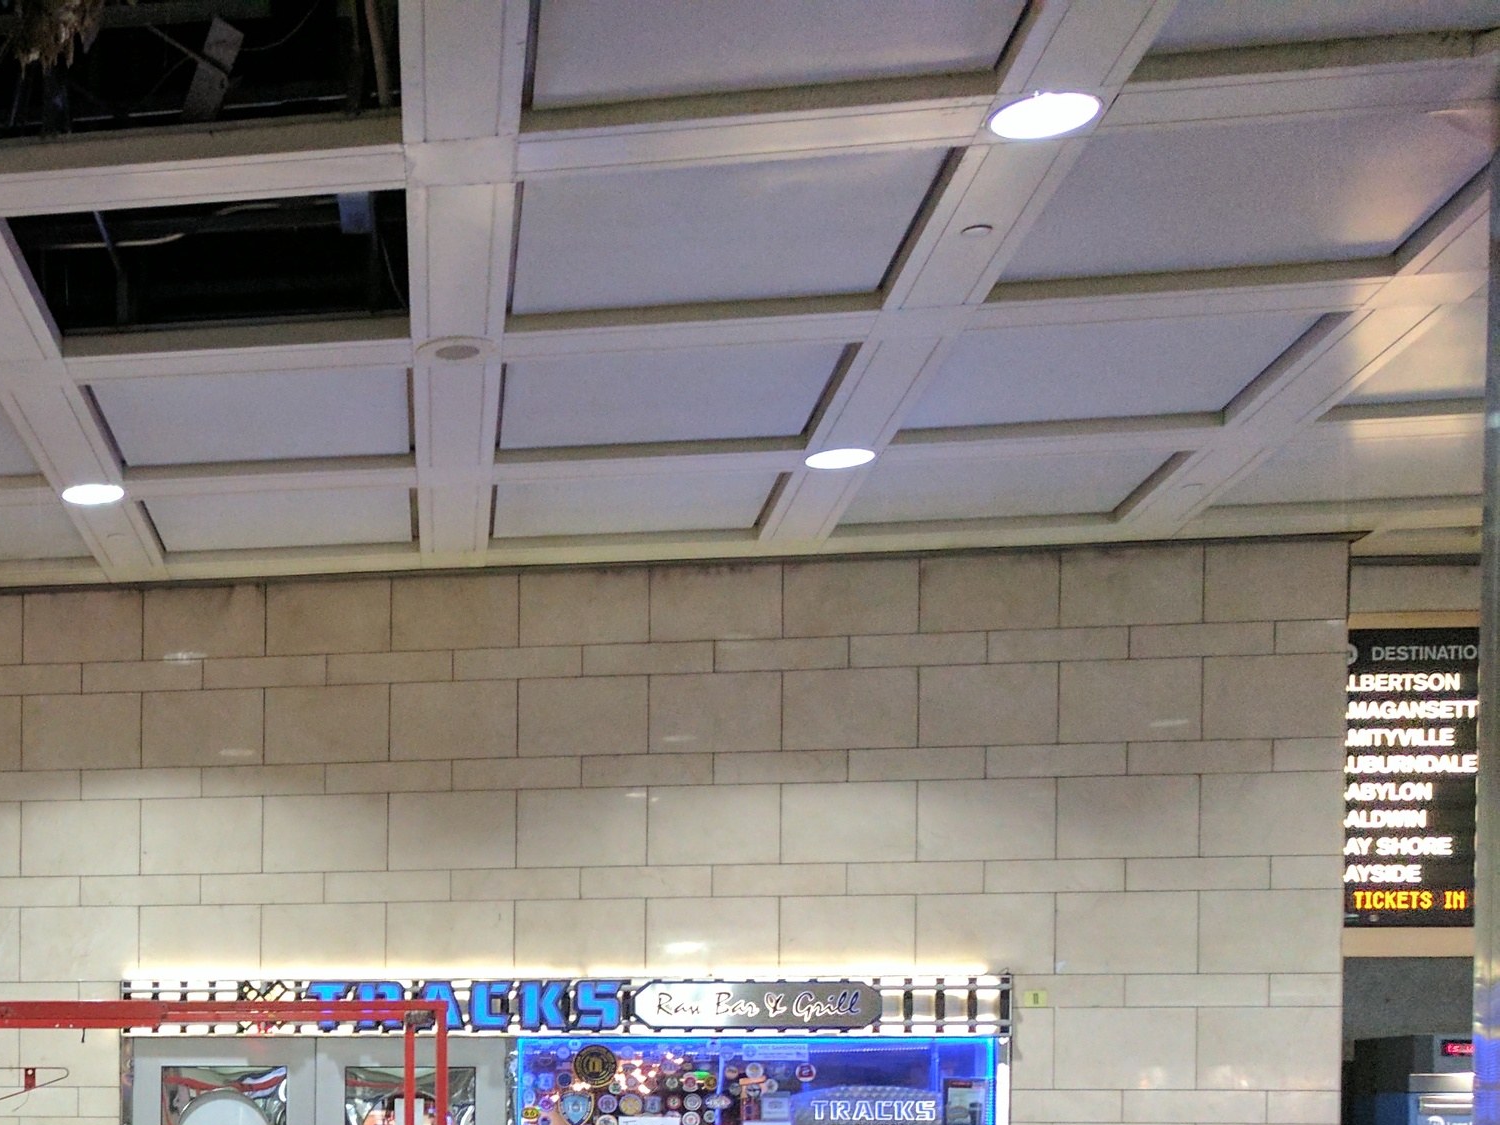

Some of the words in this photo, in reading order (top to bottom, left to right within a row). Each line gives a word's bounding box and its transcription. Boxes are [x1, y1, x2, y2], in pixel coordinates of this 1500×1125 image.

[1371, 644, 1477, 661] DESTINATIO
[1345, 672, 1461, 692] LBERTSON
[1345, 700, 1479, 719] MAGANSETT
[1344, 727, 1455, 747] MITYVILLE
[1344, 755, 1478, 773] UBURNDALE
[1343, 782, 1433, 801] ABYLON
[1343, 809, 1427, 828] ALDWIN
[1343, 837, 1373, 855] AY
[1376, 836, 1453, 855] SHORE
[1342, 864, 1422, 883] AYSIDE
[1353, 890, 1433, 910] TICKETS
[1444, 890, 1467, 910] IN
[306, 980, 621, 1031] TRACKS
[715, 992, 760, 1017] Bar
[764, 993, 787, 1018] &
[792, 989, 862, 1022] Grill
[811, 1100, 937, 1121] TRACKS
